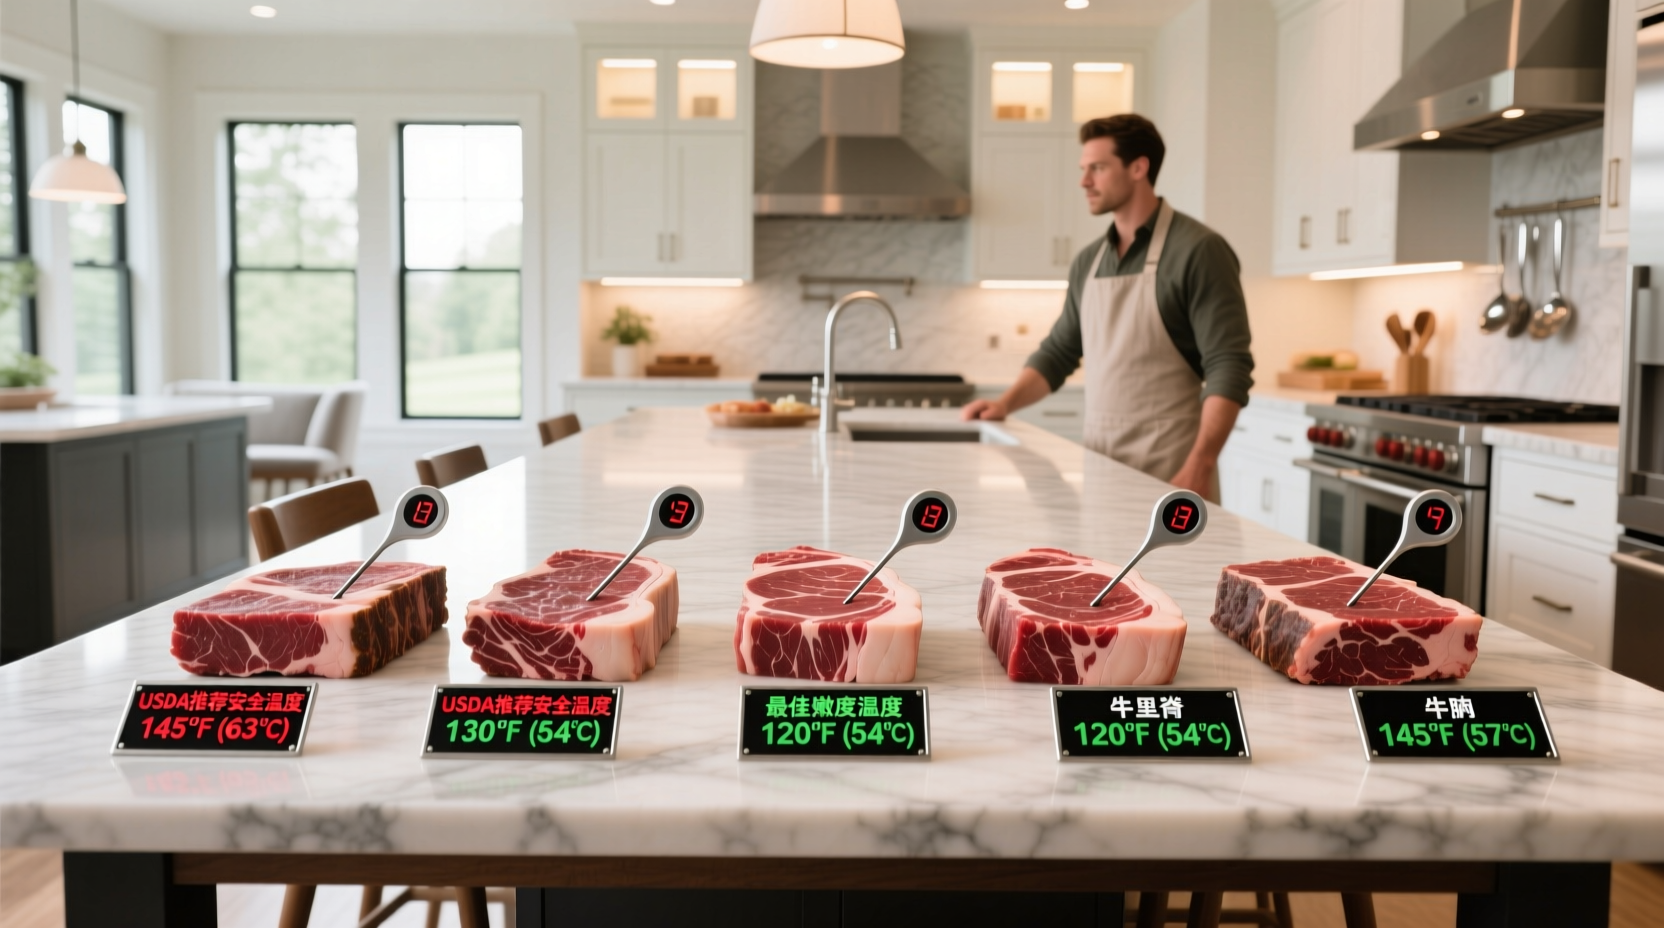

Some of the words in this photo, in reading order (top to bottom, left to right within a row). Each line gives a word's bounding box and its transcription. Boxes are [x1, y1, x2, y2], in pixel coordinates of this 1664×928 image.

[138, 690, 305, 713] USDA推荐安全温度
[441, 694, 612, 716] USDA推荐安全温度
[766, 695, 902, 718] 最佳嫩度温度
[1110, 696, 1184, 719] 牛里脊
